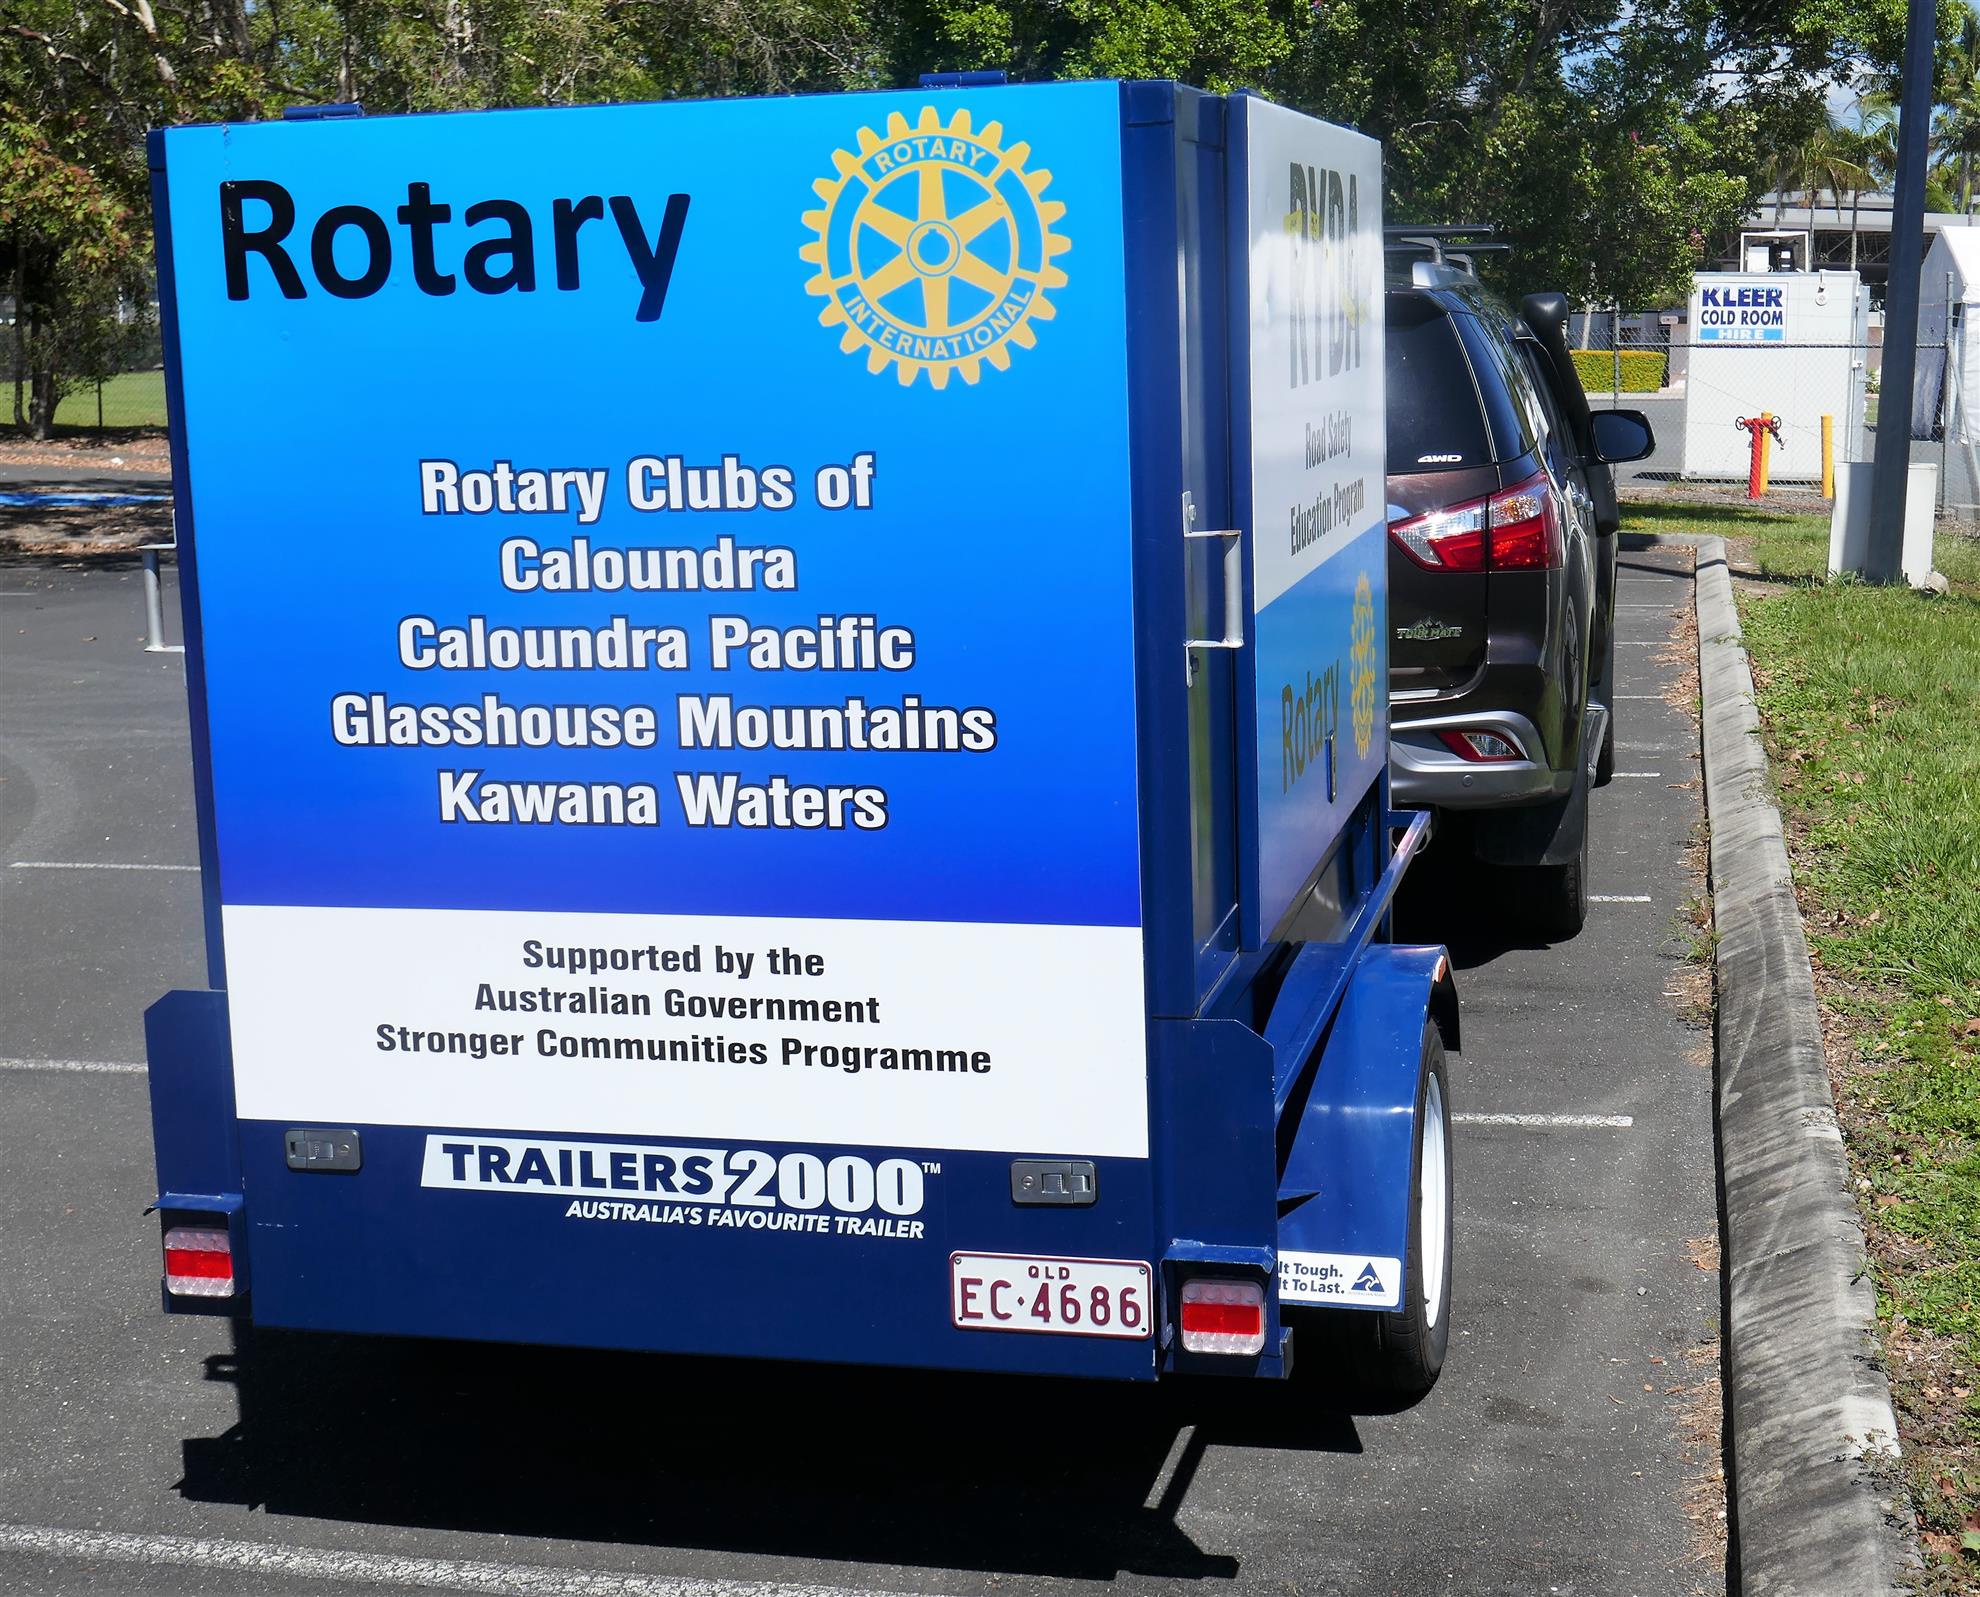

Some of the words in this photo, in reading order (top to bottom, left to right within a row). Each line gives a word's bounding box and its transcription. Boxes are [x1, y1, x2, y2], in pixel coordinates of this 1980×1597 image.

[874, 138, 986, 174] ROTARY
[219, 179, 691, 322] Rotary
[1701, 310, 1736, 326] COLD
[1741, 310, 1783, 326] ROOM
[1702, 286, 1783, 307] KLEER
[844, 289, 1031, 359] INTERNATIONAL
[1718, 329, 1765, 340] HIRE
[1305, 415, 1326, 470] Road
[1328, 410, 1352, 458] Safety
[1417, 454, 1463, 463] 4WD
[419, 458, 610, 525] Rotary
[626, 453, 797, 512] Clubs
[815, 451, 877, 510] of
[1290, 491, 1332, 556] Education
[1333, 477, 1364, 527] Program
[499, 534, 799, 593] Caloundra
[397, 614, 690, 671] Caloundra
[708, 613, 916, 671] Pacific
[330, 691, 658, 748] Glasshouse
[676, 693, 997, 752] Mountains
[1282, 659, 1339, 797] Rotary
[437, 768, 660, 827] Kawana
[673, 771, 889, 831] Waters
[523, 940, 701, 975] Supported
[715, 945, 755, 979] by
[766, 947, 825, 977] the
[474, 983, 651, 1016] Australian
[664, 989, 881, 1024] Government
[376, 1024, 525, 1059] Stronger
[536, 1029, 768, 1065] Communities
[781, 1037, 992, 1074] Programme
[442, 1143, 714, 1195] TRAILERS
[729, 1150, 924, 1216] 2000
[565, 1200, 703, 1226] AUSTRALIA'S
[707, 1208, 831, 1233] FAVOURITE
[834, 1216, 925, 1239] TRAILER
[1028, 1265, 1071, 1280] QLD
[1292, 1278, 1308, 1292] To
[1310, 1280, 1345, 1294] Last.
[1293, 1262, 1343, 1280] Tough.
